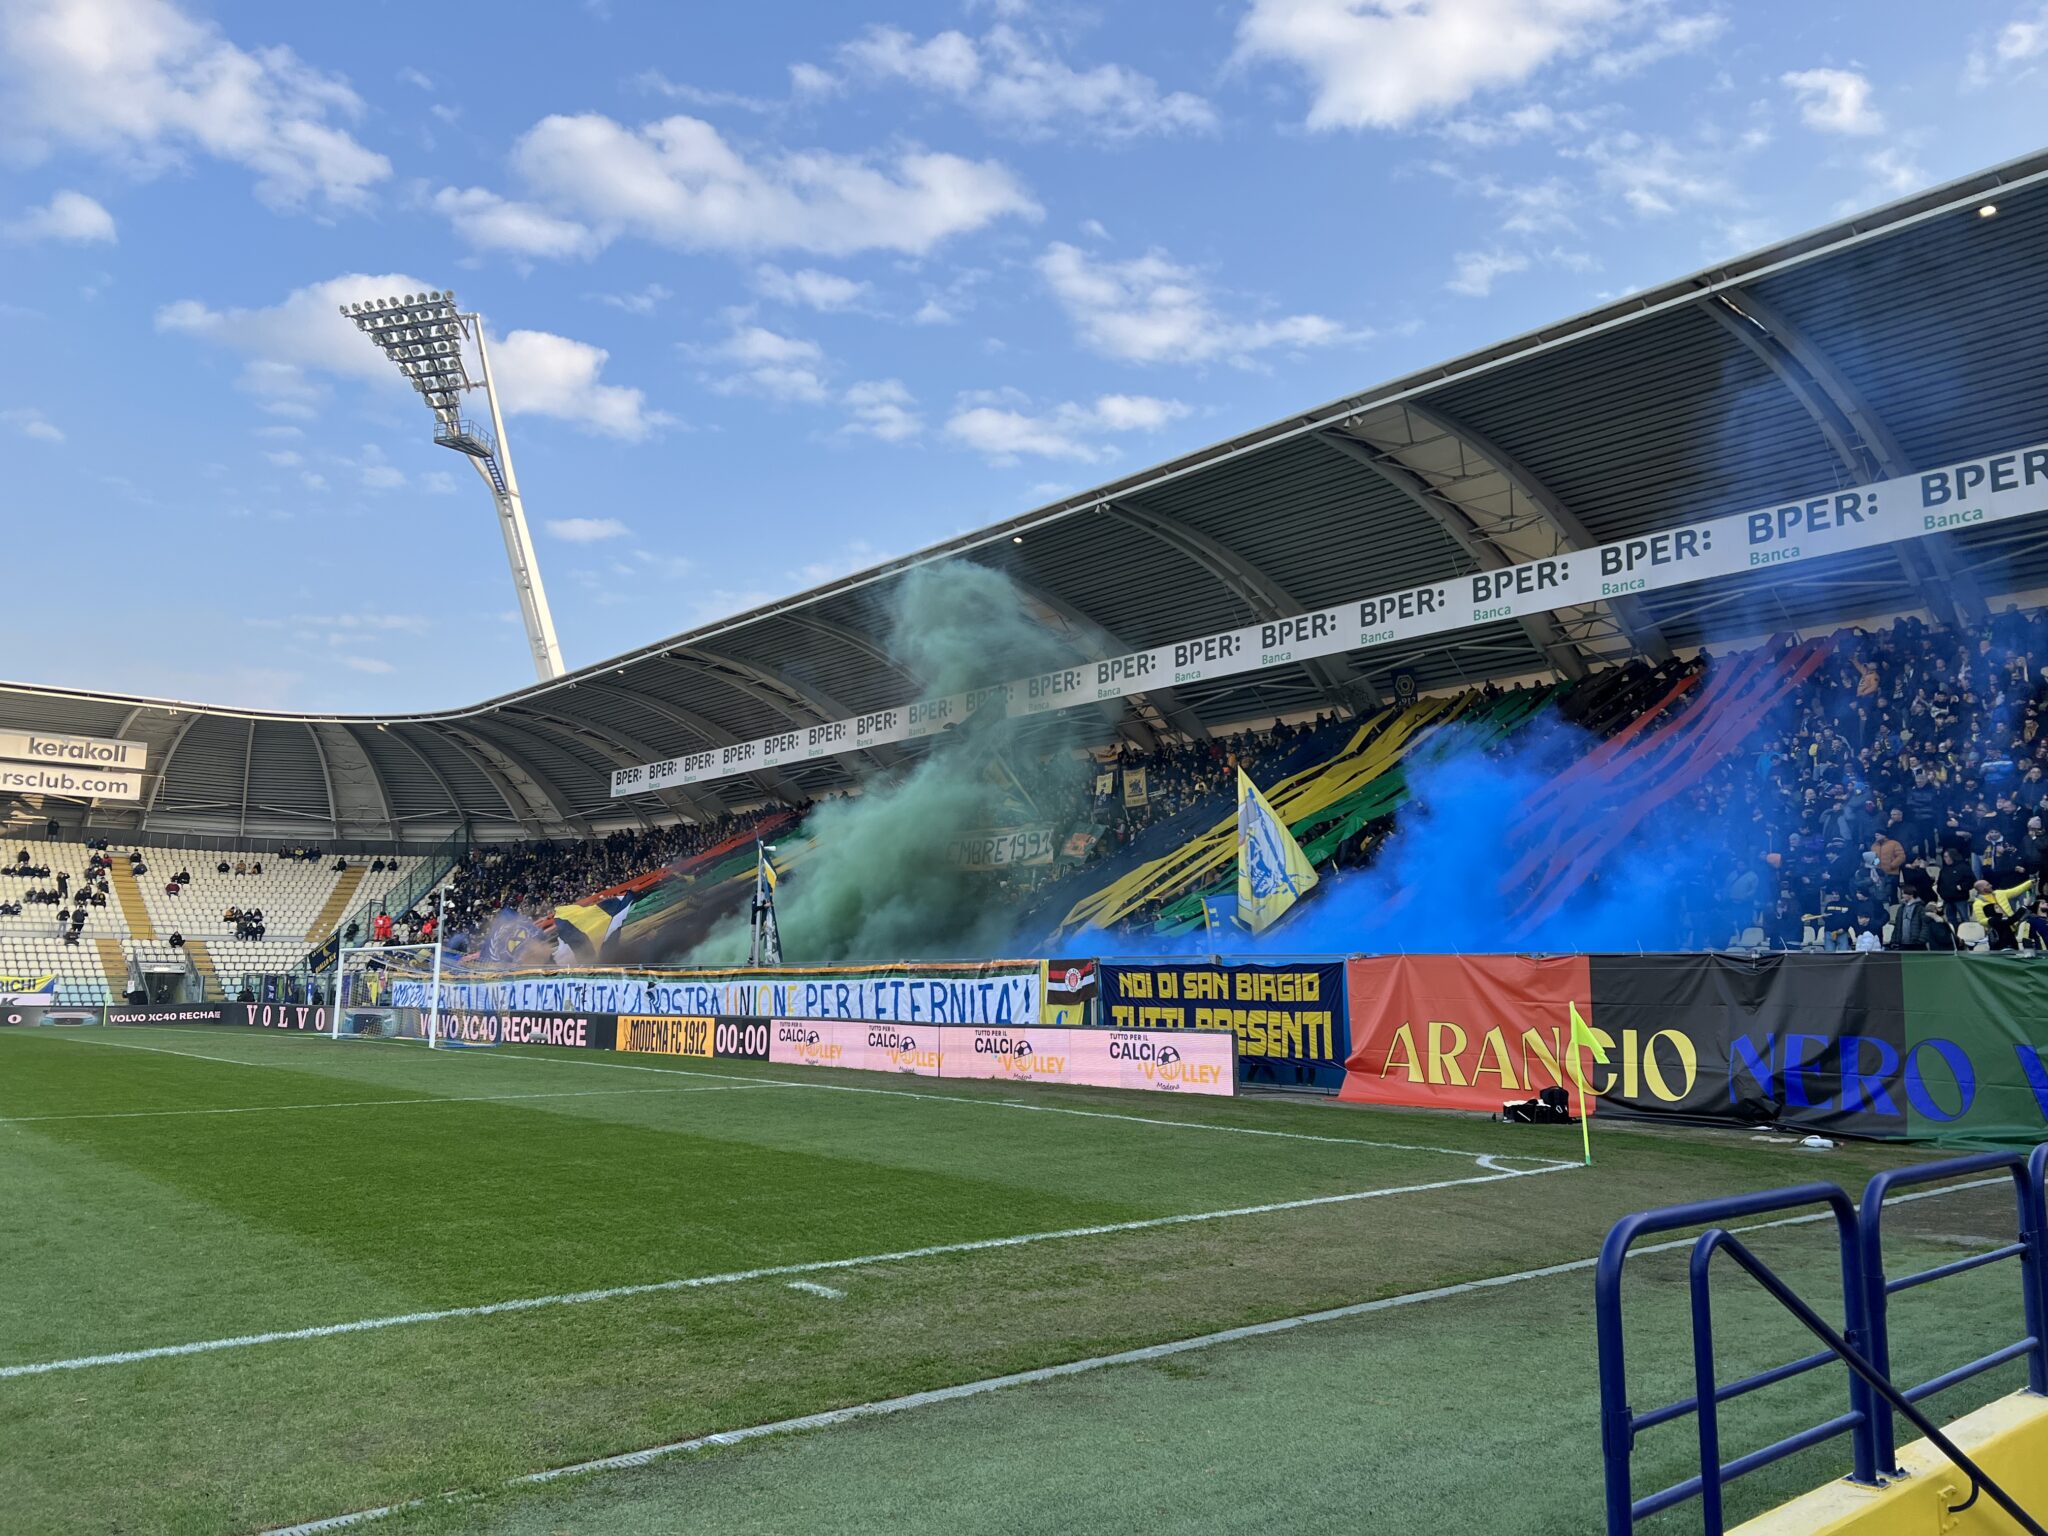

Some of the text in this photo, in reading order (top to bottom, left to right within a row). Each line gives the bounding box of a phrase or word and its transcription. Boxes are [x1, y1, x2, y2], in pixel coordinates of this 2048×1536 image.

[1921, 450, 2048, 508] BPER
[1748, 492, 1878, 545] BPER:
[1923, 509, 1983, 531] Banca
[1600, 529, 1712, 577] BPER:
[1749, 546, 1800, 567] Banca
[1472, 560, 1569, 603] BPER:
[1601, 577, 1646, 596] Banca
[1360, 588, 1445, 627] BPER:
[1473, 604, 1511, 621] Banca
[1262, 614, 1337, 649] BPER:
[1361, 629, 1394, 645] Banca
[1175, 635, 1241, 668] BPER:
[1262, 650, 1292, 665] Banca
[1098, 654, 1156, 684] BPER:
[1175, 669, 1201, 683] Banca
[1029, 670, 1081, 699] BPER:
[1098, 686, 1121, 699] Banca
[809, 723, 846, 746] BPER:
[857, 712, 897, 735] BPER:
[28, 737, 127, 762] kerakoll
[723, 744, 755, 764] BPER:
[764, 734, 799, 755] BPER:
[650, 761, 677, 780] BPER:
[685, 753, 715, 772] BPER:
[0, 772, 128, 794] rsclub.com
[615, 769, 642, 786] BPER:
[1118, 972, 1320, 1001] NOI DI SAN BIAGIO
[806, 983, 850, 1018] PER
[110, 1014, 146, 1023] VOLVO
[148, 1013, 176, 1021] XC40
[247, 1005, 325, 1030] VOLVO
[461, 1014, 497, 1041] XC40
[501, 1016, 588, 1047] RECHARGE
[630, 1019, 707, 1055] MODENA FC 1912
[716, 1024, 768, 1055] 00:00
[1195, 1008, 1333, 1059] PRESENTI
[1380, 1021, 1697, 1102] ARANCIO
[1728, 1032, 1976, 1122] NERO
